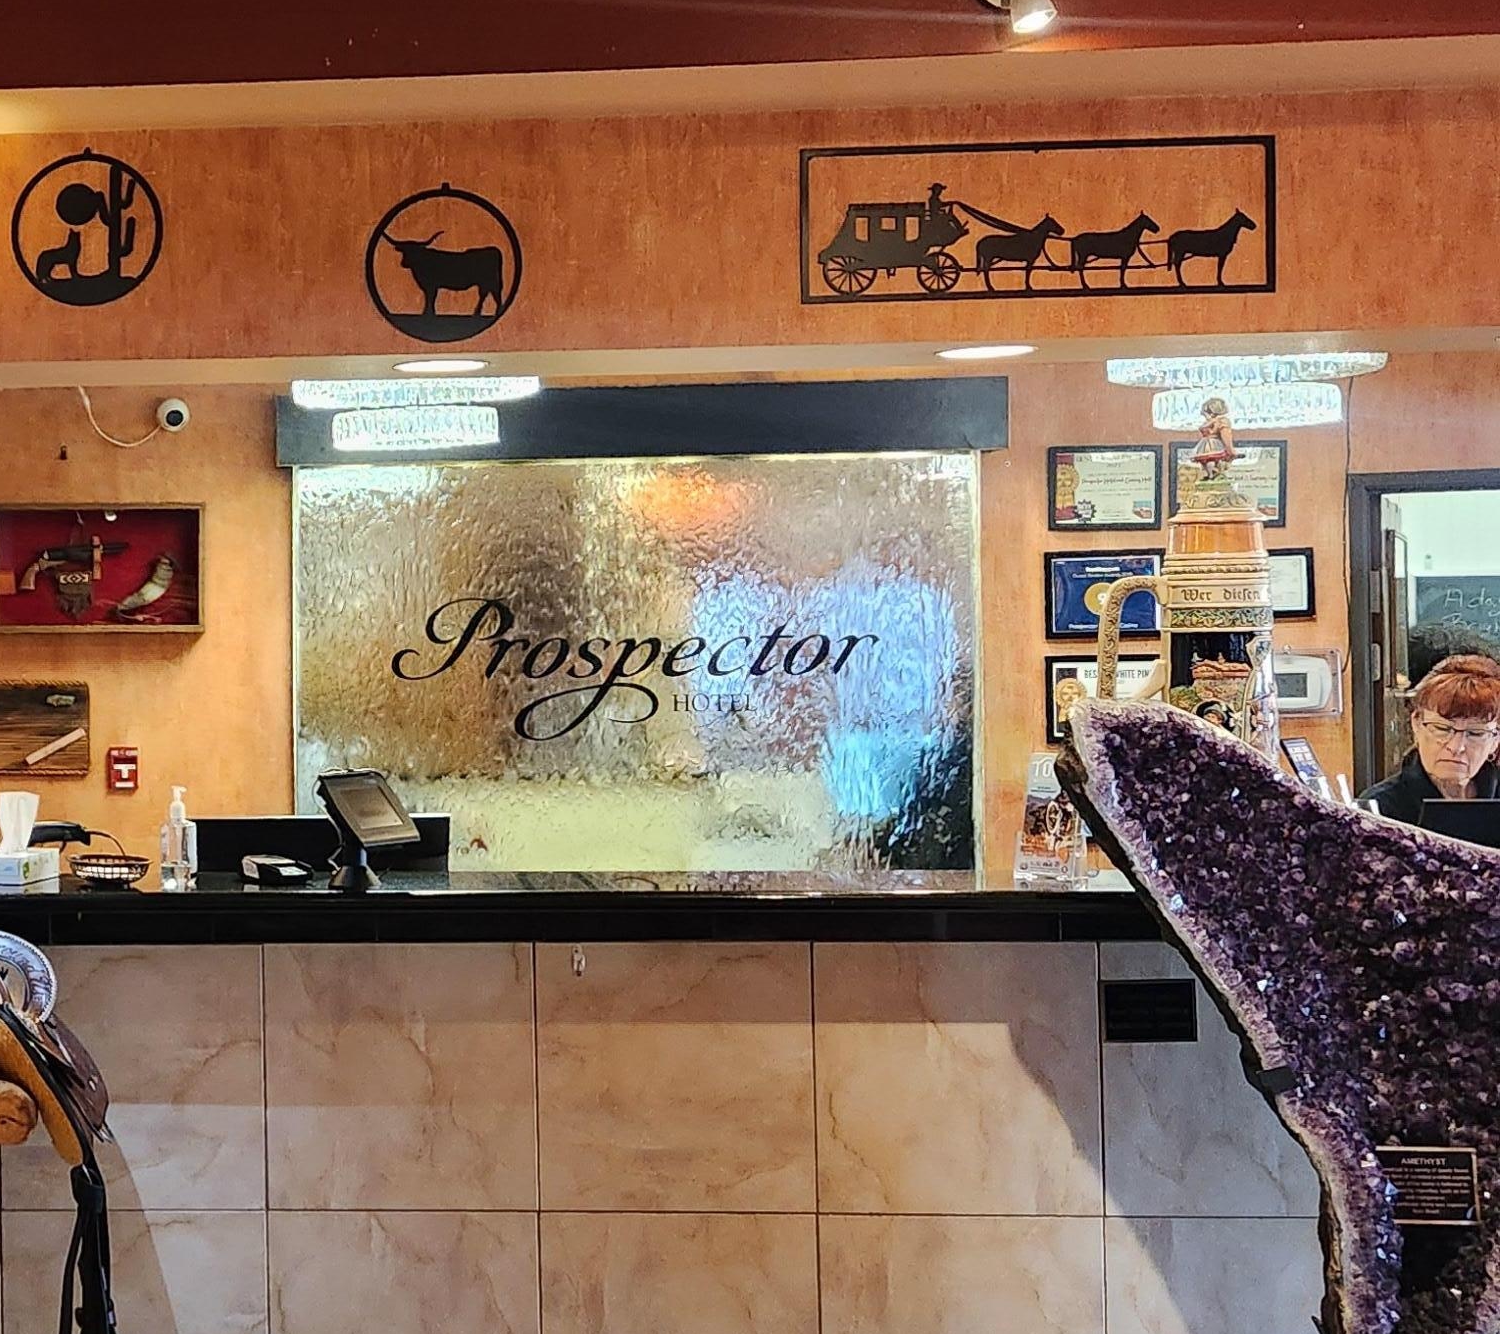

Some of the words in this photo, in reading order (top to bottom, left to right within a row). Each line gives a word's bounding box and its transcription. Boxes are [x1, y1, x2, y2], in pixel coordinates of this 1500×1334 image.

[391, 596, 878, 742] Prospector
[673, 693, 757, 713] HOTEL
[1401, 1158, 1446, 1166] AMETHYST
